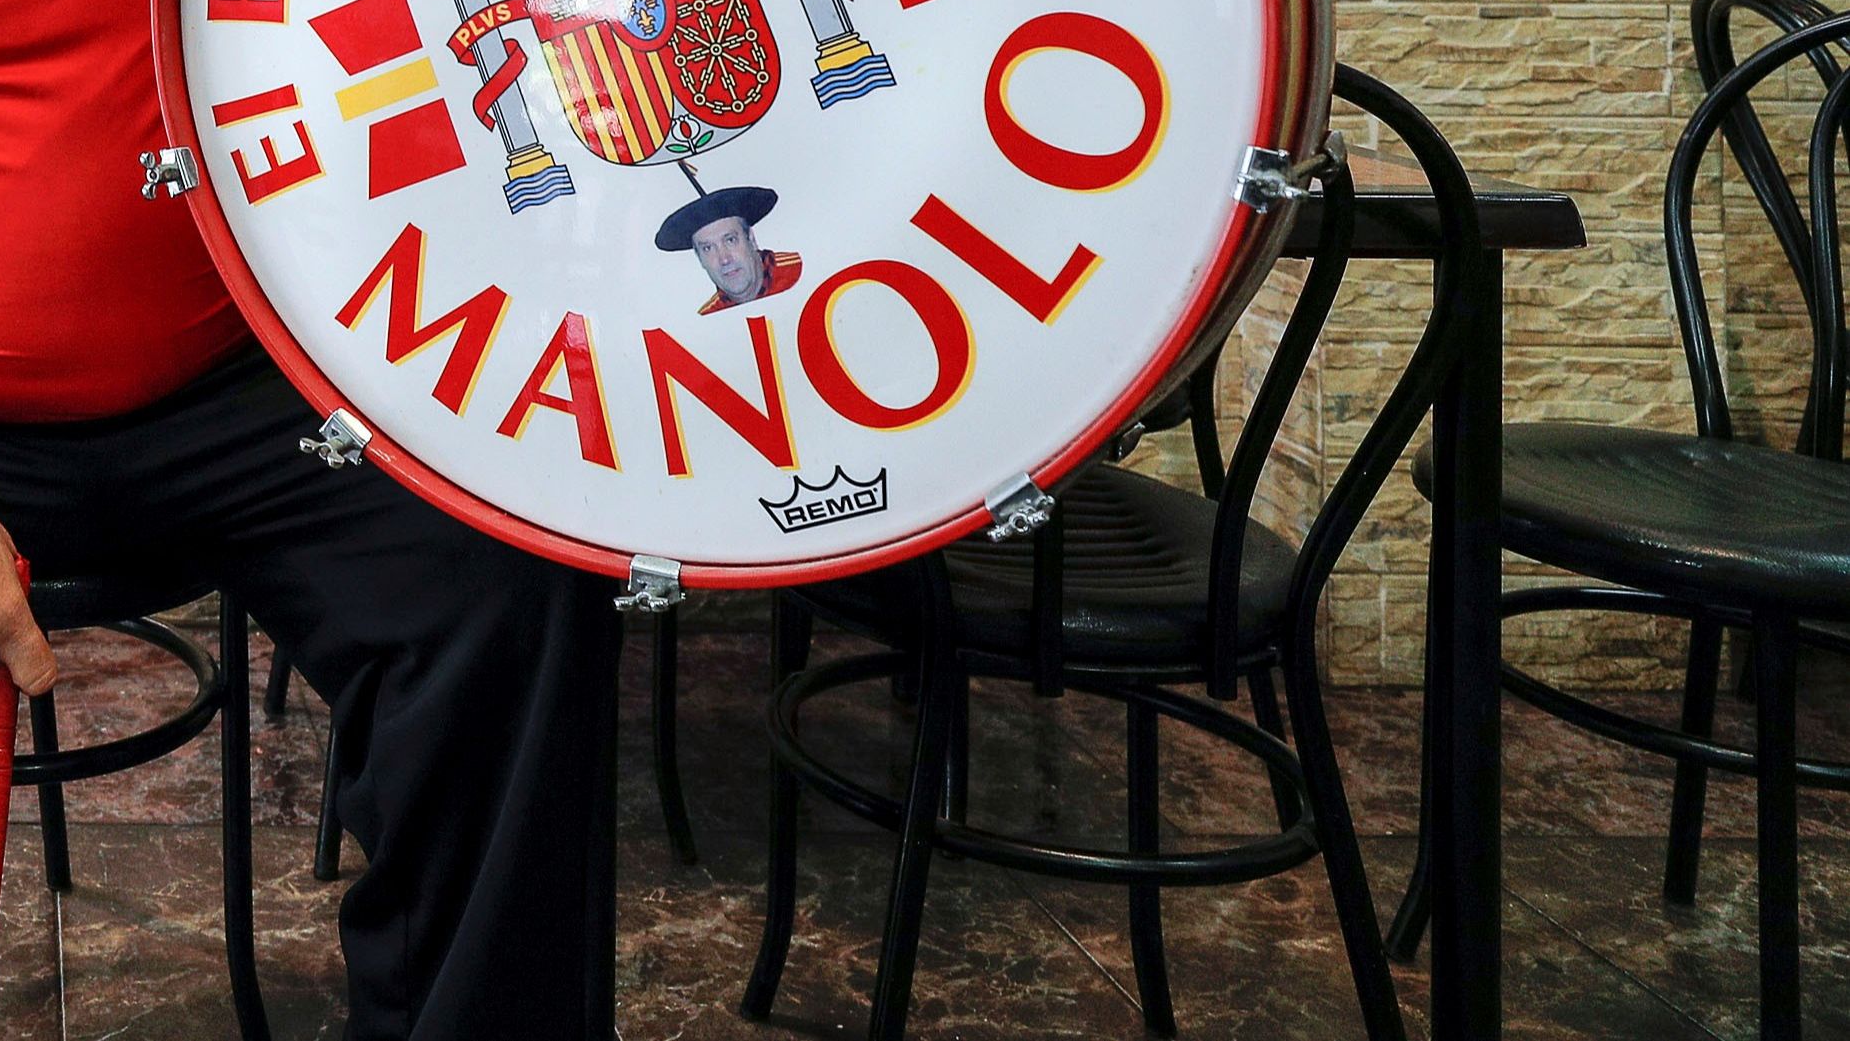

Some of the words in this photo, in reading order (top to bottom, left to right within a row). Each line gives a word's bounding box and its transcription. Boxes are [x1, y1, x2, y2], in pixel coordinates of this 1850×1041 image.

[458, 3, 512, 48] PLVS
[211, 83, 326, 207] El
[334, 11, 1173, 480] MANOLO
[783, 489, 878, 525] REMO
